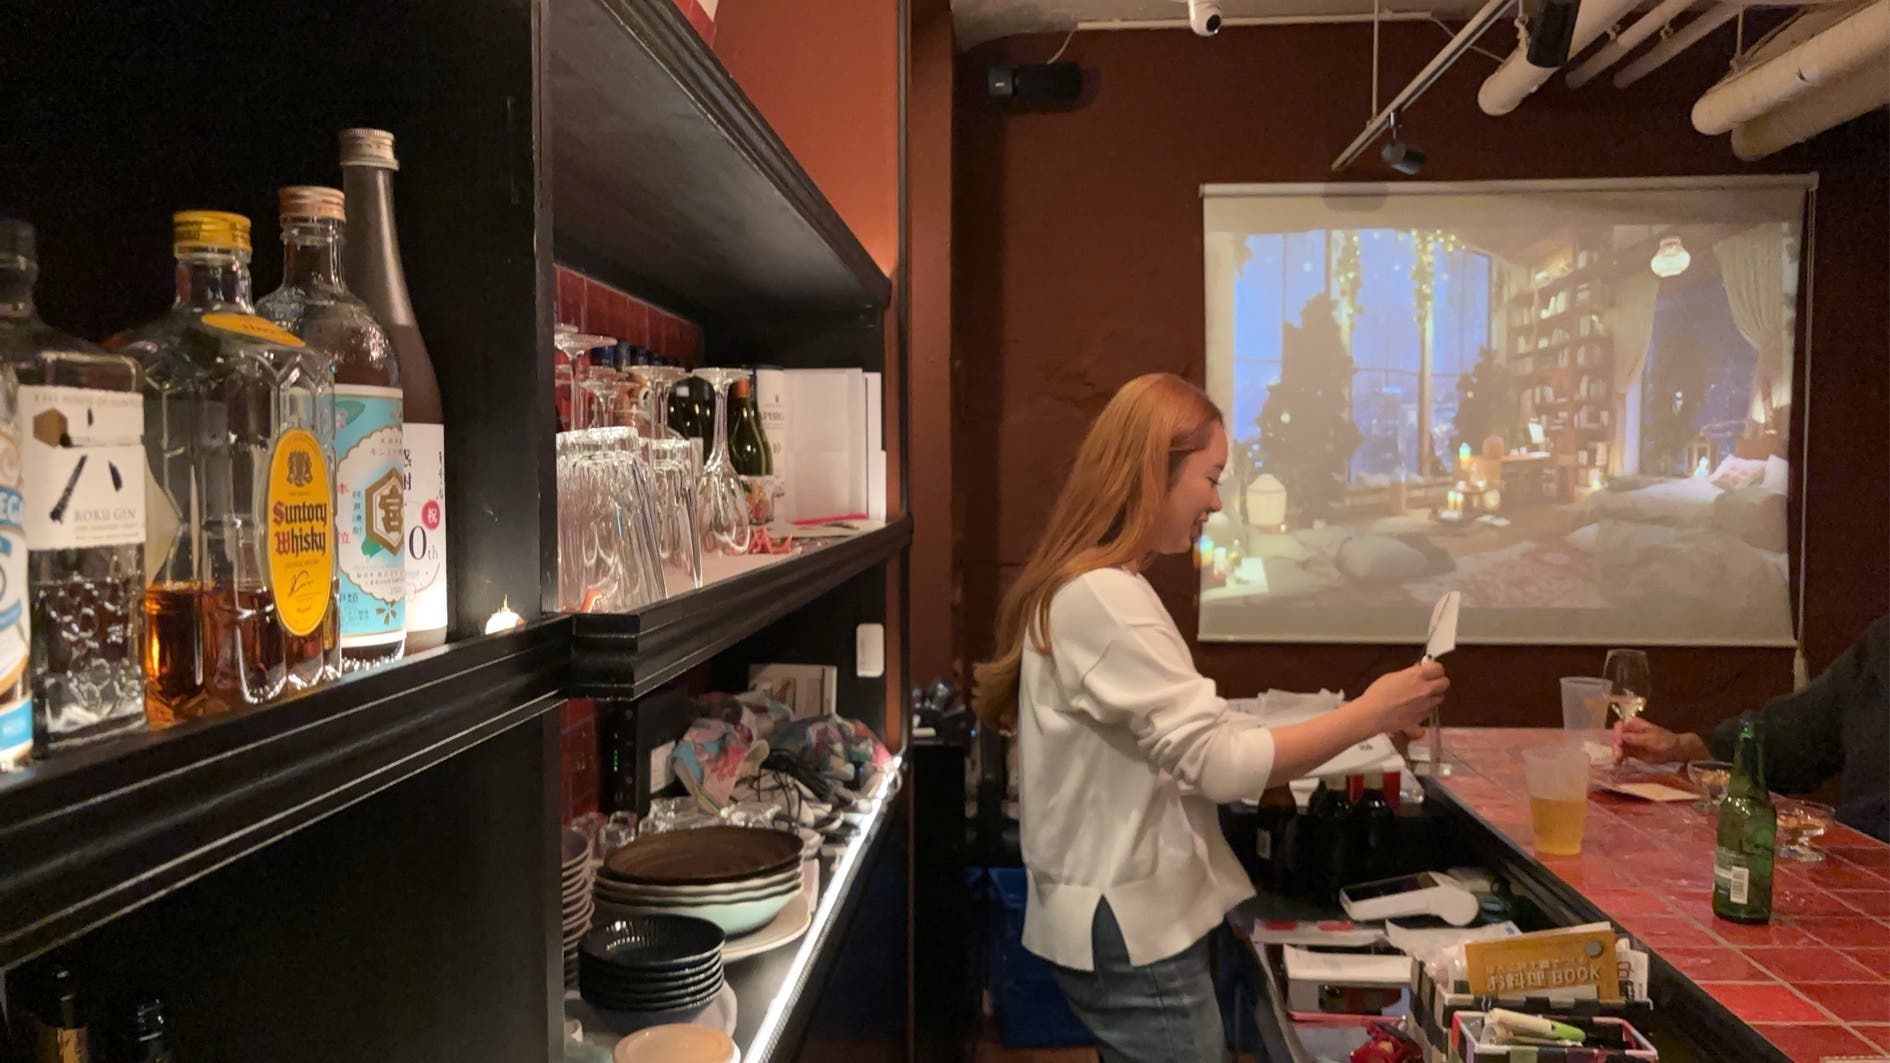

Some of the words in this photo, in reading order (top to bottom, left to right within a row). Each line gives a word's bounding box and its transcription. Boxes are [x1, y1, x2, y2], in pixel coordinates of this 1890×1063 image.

[74, 508, 111, 522] ROKU
[112, 507, 137, 521] GIN
[273, 500, 328, 526] Suntory
[275, 527, 326, 559] Whisky
[1551, 963, 1601, 985] BOOK
